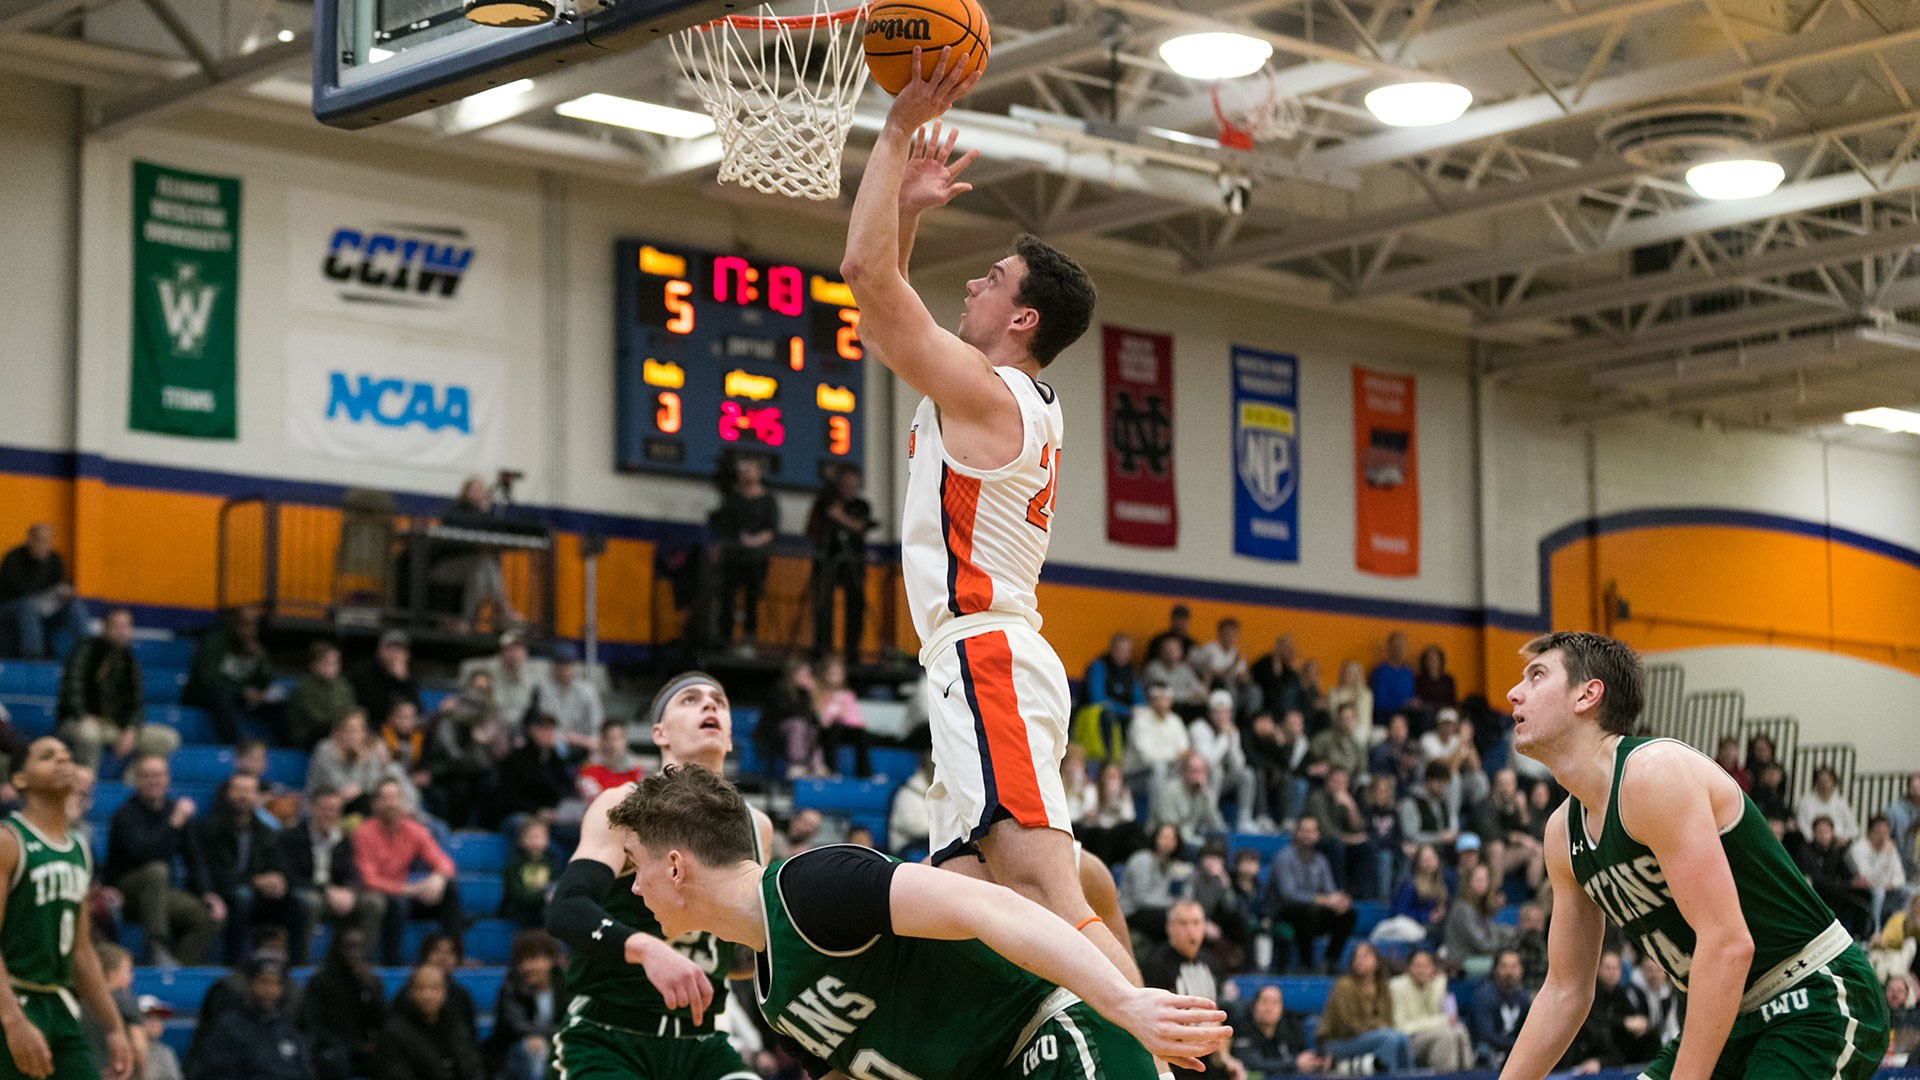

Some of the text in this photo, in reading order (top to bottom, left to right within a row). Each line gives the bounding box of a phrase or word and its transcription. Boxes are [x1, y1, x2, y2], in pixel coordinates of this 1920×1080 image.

[322, 228, 475, 298] CCIW
[664, 279, 695, 335] 5
[324, 370, 474, 434] NCAA
[1760, 987, 1810, 1024] IWU
